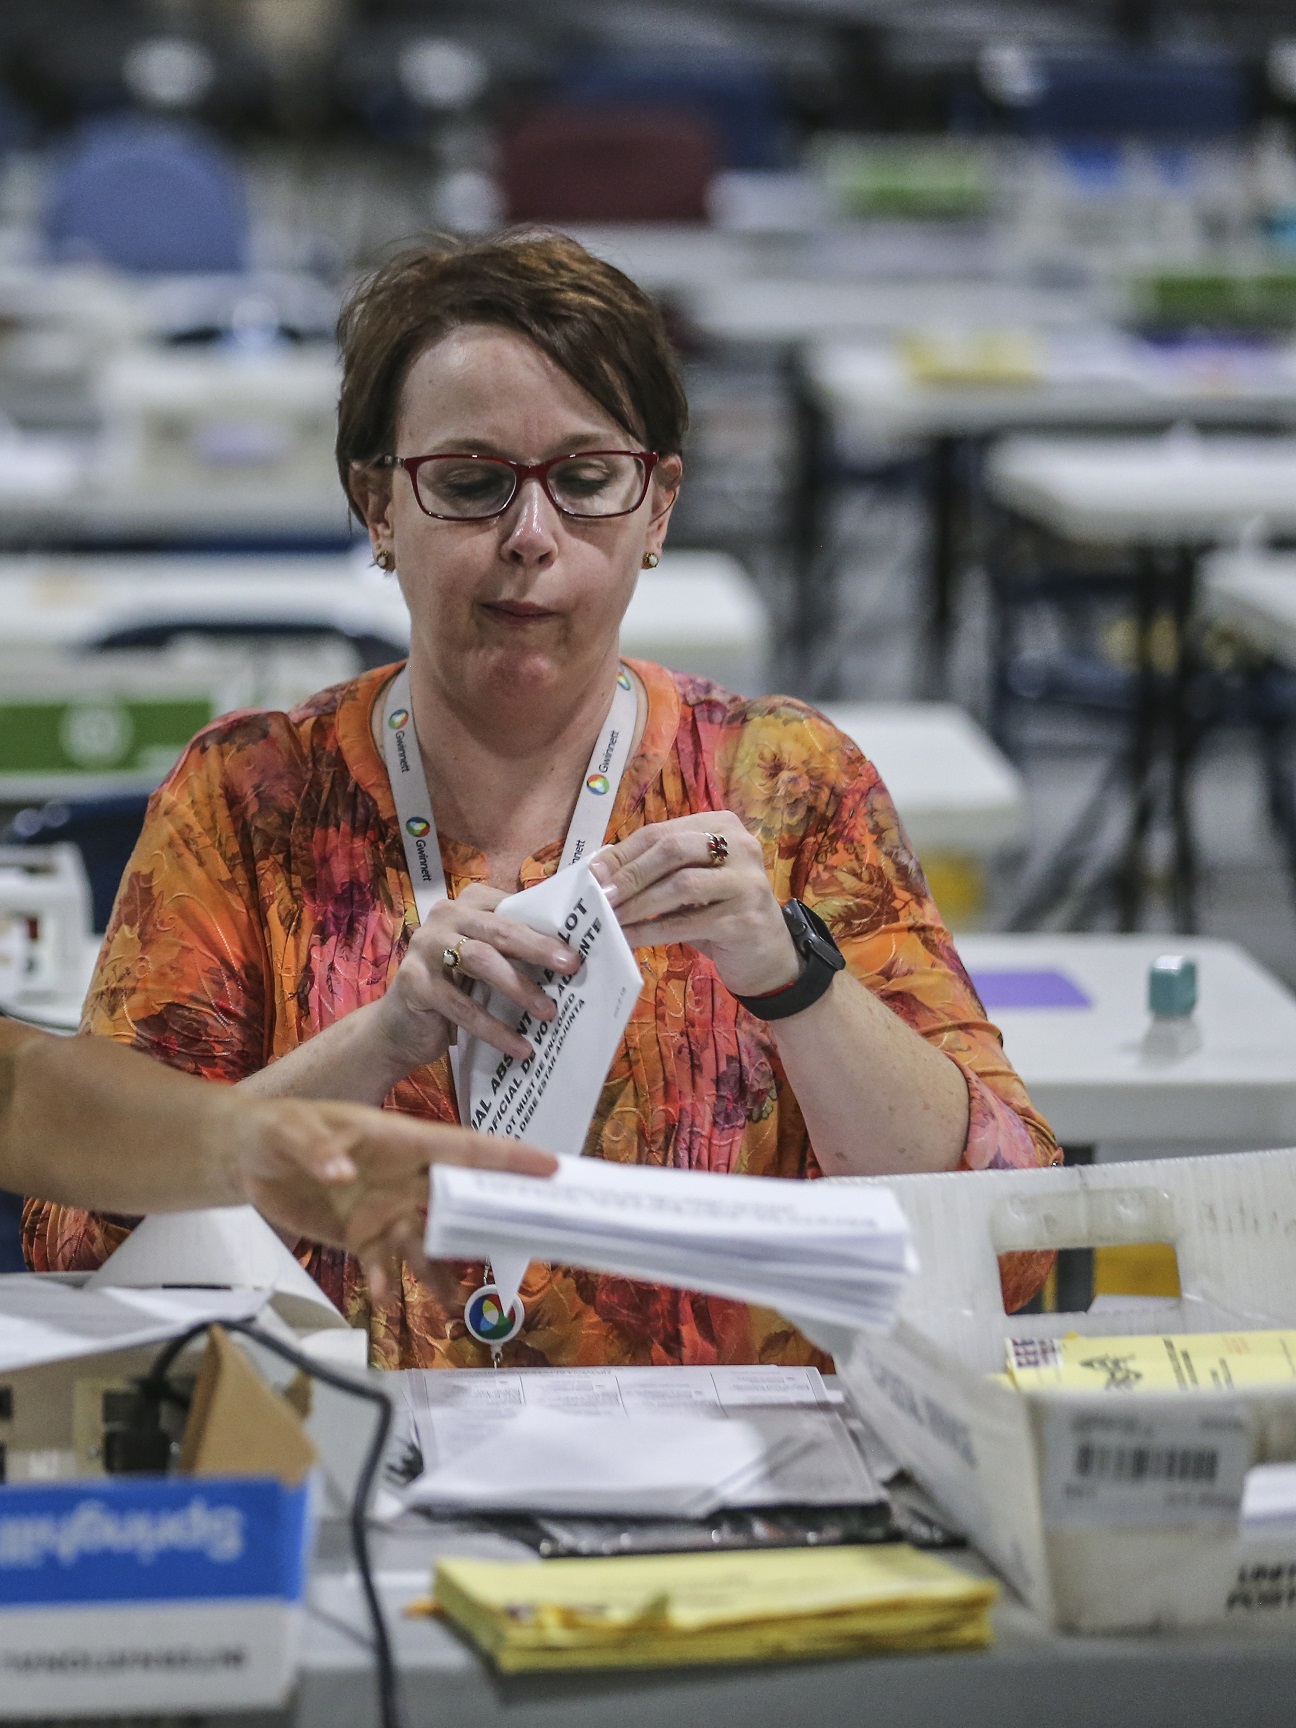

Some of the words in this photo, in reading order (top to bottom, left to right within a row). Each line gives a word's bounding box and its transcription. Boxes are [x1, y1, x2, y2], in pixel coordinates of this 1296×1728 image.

[395, 730, 411, 773] Gwinnett
[598, 729, 620, 774] Gwinnett
[415, 839, 432, 882] Gwinnett
[568, 839, 586, 865] nnett
[557, 916, 602, 997] AUENTE
[555, 998, 585, 1056] ADJUNTA
[515, 1078, 536, 1116] MUST
[543, 992, 575, 1060] ENCLOSED
